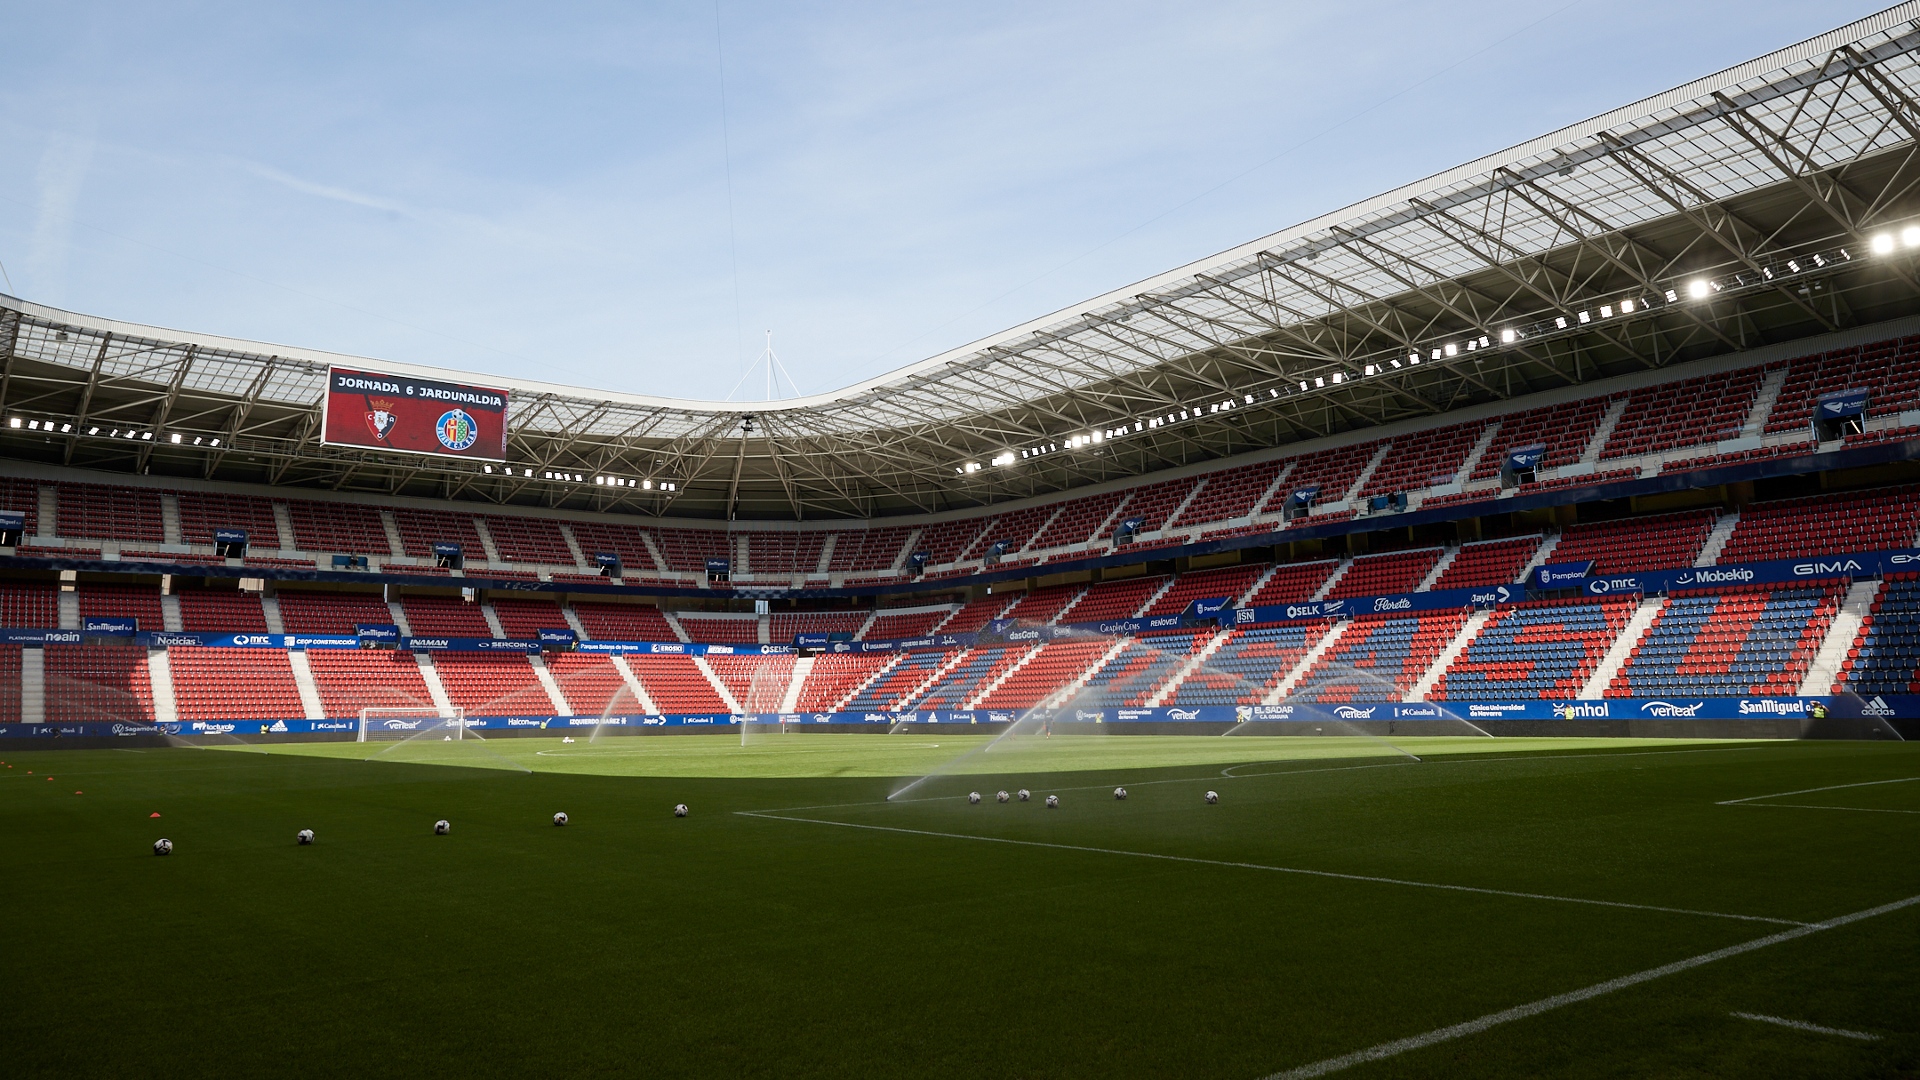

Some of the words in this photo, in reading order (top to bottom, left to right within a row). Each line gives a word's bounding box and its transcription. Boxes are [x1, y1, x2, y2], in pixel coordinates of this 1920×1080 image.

[338, 376, 400, 394] JORNADA
[405, 385, 414, 395] 6
[419, 387, 502, 406] JARDUNALDIA
[1891, 554, 1920, 564] EX
[1793, 560, 1862, 575] GIMA
[1696, 568, 1754, 583] Mobekip
[1611, 578, 1636, 588] mrc
[1471, 593, 1496, 603] Jaylo
[1204, 604, 1221, 612] Pamplo
[1374, 597, 1412, 612] Florette
[1296, 605, 1320, 616] SELK
[1150, 616, 1178, 627] RENOVEN
[250, 635, 269, 643] mrc
[1009, 630, 1039, 640] dasGate
[157, 636, 196, 645] Noticias
[409, 638, 449, 647] INAMAN
[769, 645, 790, 653] SELK
[1254, 706, 1264, 714] EL
[1265, 705, 1293, 714] SADAR
[1409, 708, 1435, 716] CaixaBank
[1572, 702, 1609, 717] nhol
[1861, 708, 1895, 716] adidas
[124, 724, 158, 733] Sagamóvil
